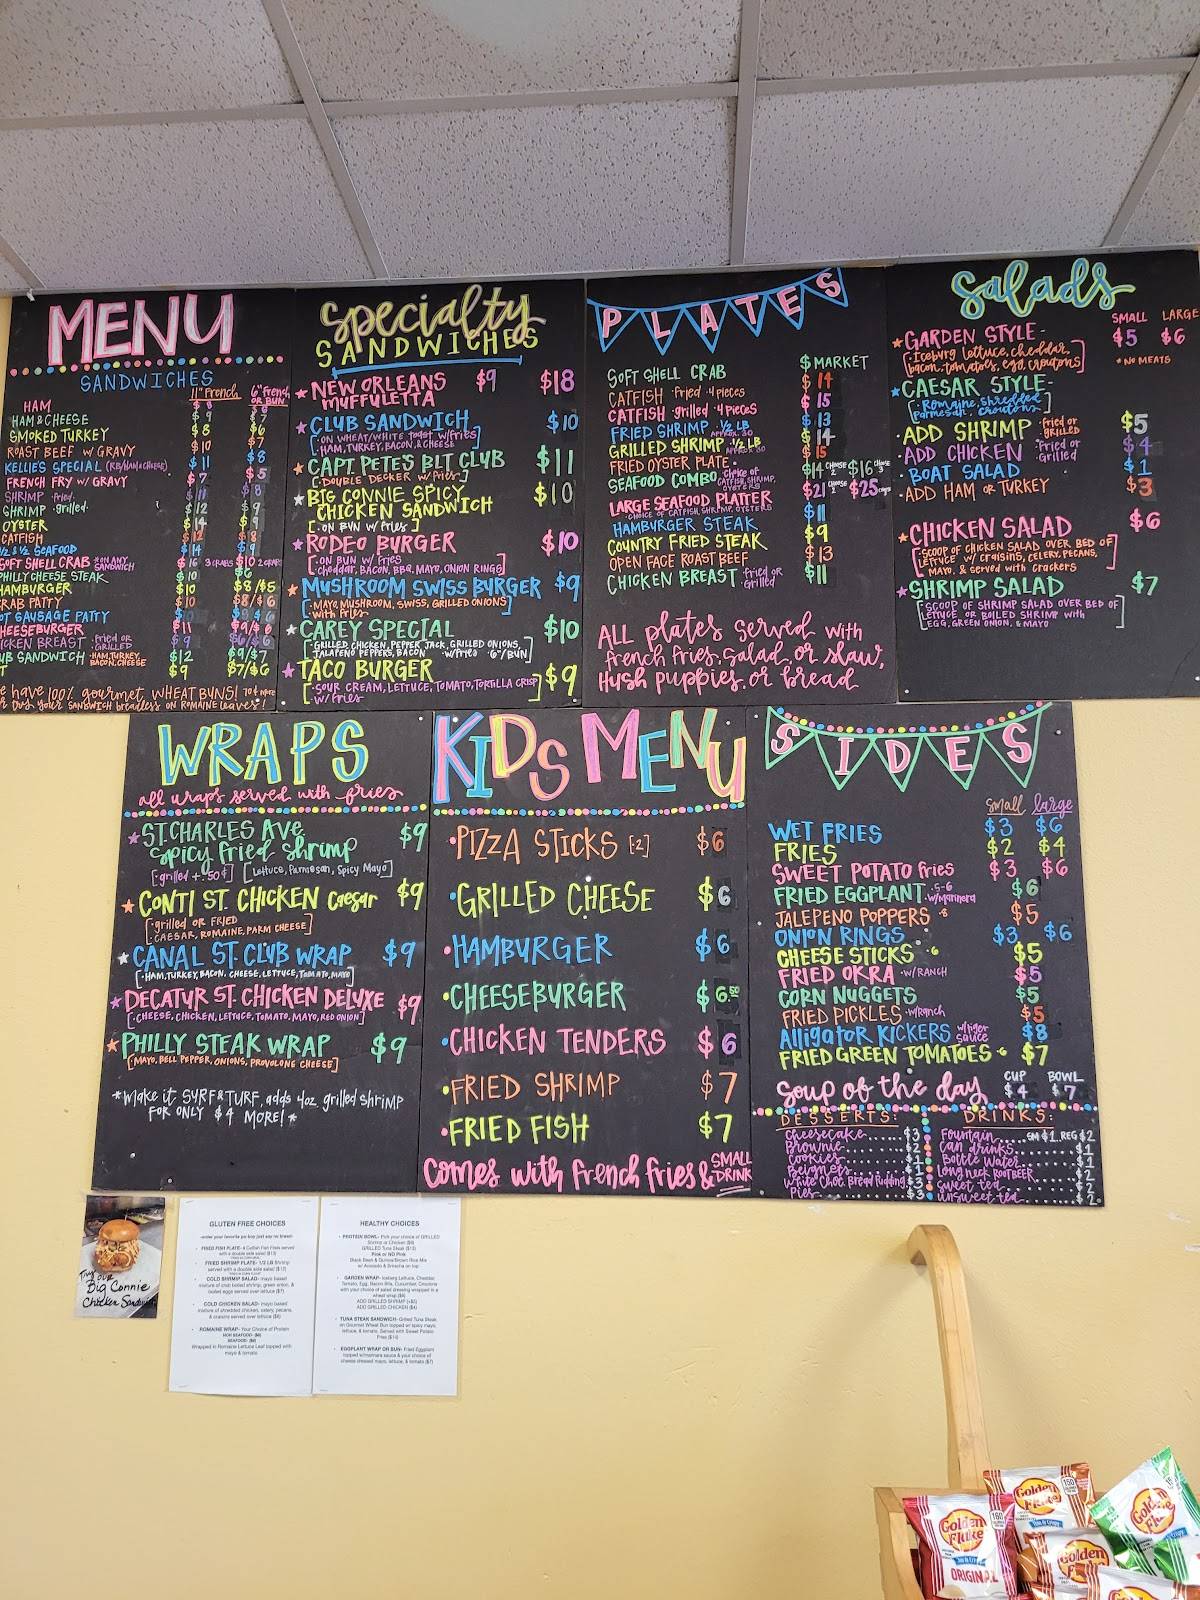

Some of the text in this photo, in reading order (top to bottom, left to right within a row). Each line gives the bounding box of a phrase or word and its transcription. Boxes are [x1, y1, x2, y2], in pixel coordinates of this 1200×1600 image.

[602, 273, 840, 339] PLATES
[1112, 309, 1200, 323] SMALL LARGE
[48, 294, 234, 365] MENU
[904, 330, 975, 350] GARDEN
[316, 329, 539, 368] SANDWICHES
[81, 371, 213, 391] SANDWICHES
[643, 367, 680, 380] SHELL
[691, 365, 726, 379] CRAB
[311, 379, 356, 400] NEW
[361, 372, 446, 393] ORLEANS
[902, 378, 980, 398] CAESAR
[24, 400, 51, 412] HAM
[310, 410, 469, 435] CLUB SANDWICH
[611, 421, 708, 443] FRIED SHRIMP
[903, 420, 1032, 444] ADD SHRIMP
[61, 428, 109, 441] TURKEY
[45, 446, 74, 458] BEEF
[97, 445, 135, 457] GRAVY
[422, 453, 453, 473] BLT
[459, 450, 505, 468] CLUB
[53, 461, 101, 473] SPECIAL
[610, 456, 728, 476] FRIED OYSTER PLATE
[908, 463, 1020, 485] BOAT SALAD
[7, 475, 128, 488] FRENCH FRY GRAVY
[906, 478, 1049, 501] ADD HAM TURKEY
[307, 485, 464, 507] BIG CONNIE SPICY
[610, 491, 772, 517] LARGE SEAFOOD PLATTER
[317, 496, 493, 520] CHICKEN SANDWICH
[3, 520, 48, 532] OYSTER
[909, 518, 994, 546] CHICKEN
[1002, 516, 1072, 538] SALAD
[376, 532, 456, 553] BURGER
[608, 532, 767, 556] COUNTRY FRIED STEAK
[25, 557, 90, 570] SHELL CRAB
[413, 579, 467, 597] SWISS
[473, 578, 541, 600] BURGER
[908, 580, 987, 599] SHRIMP
[994, 576, 1064, 598] SALAD
[15, 610, 110, 623] SAUSAGE PATTY
[735, 611, 862, 642] served with
[300, 619, 454, 641] CAREY SPECIAL
[17, 652, 85, 664] SANDWICH
[297, 660, 433, 682] TACO BURGER
[152, 687, 196, 700] WHEAT
[158, 719, 368, 786] WRAPS
[433, 709, 745, 804] KIDS MENU
[771, 723, 1031, 775] SIDES
[229, 785, 330, 804] served with
[768, 822, 882, 844] WET FRIES
[456, 825, 617, 864] PIZZA STICKS
[772, 864, 842, 885] SWEET
[918, 861, 954, 877] fries
[457, 881, 655, 918] GRILLED CHEESE
[774, 883, 926, 909] FRIED EGGPLANT
[841, 926, 905, 946] RINGS
[133, 942, 352, 971] CANAL CLUB WRAP
[451, 933, 613, 968] HAMBURGER
[125, 985, 384, 1012] DECATUR CHICKEN DELUXE
[450, 981, 626, 1014] CHEESEBURGER
[833, 987, 917, 1005] NUGGETS
[122, 1032, 330, 1059] PHILLY STEAK WRAP
[450, 1024, 667, 1056] CHICKEN TENDERS
[877, 1024, 951, 1045] KICKERS
[779, 1050, 832, 1070] FRIED
[836, 1047, 897, 1066] GREEN
[906, 1044, 991, 1065] TOMATOES
[1004, 1071, 1083, 1082] CUP BOWL
[323, 1089, 357, 1111] grilled
[449, 1113, 589, 1146] FRIED FISH
[711, 1152, 752, 1182] SMALL DRINK
[88, 1280, 150, 1298] Big Connie
